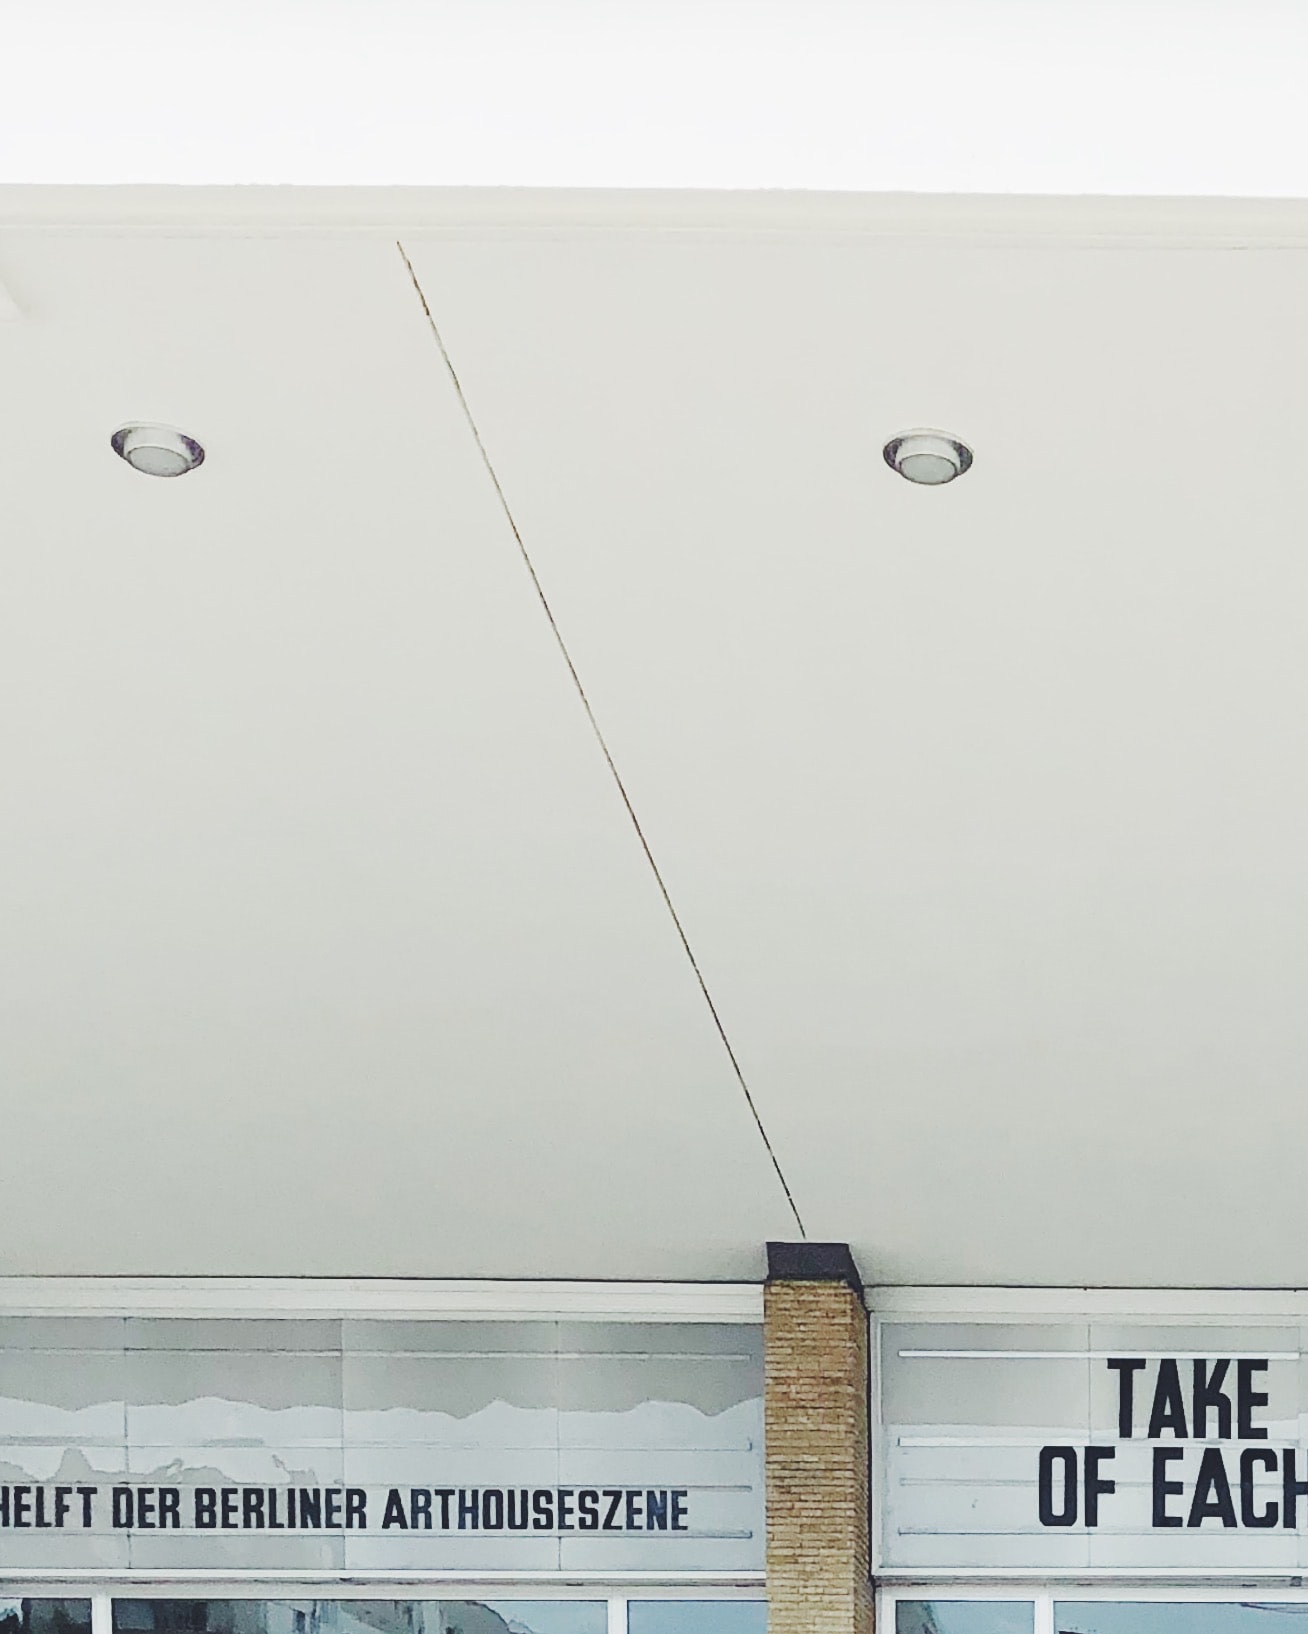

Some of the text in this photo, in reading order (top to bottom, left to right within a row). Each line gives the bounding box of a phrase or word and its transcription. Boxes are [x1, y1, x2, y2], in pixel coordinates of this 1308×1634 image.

[1107, 1357, 1269, 1440] TAKE
[112, 1487, 181, 1529] DER
[194, 1487, 367, 1530] BERLINER
[381, 1488, 688, 1531] ARTHOUSESZENE
[1038, 1445, 1116, 1528] OF
